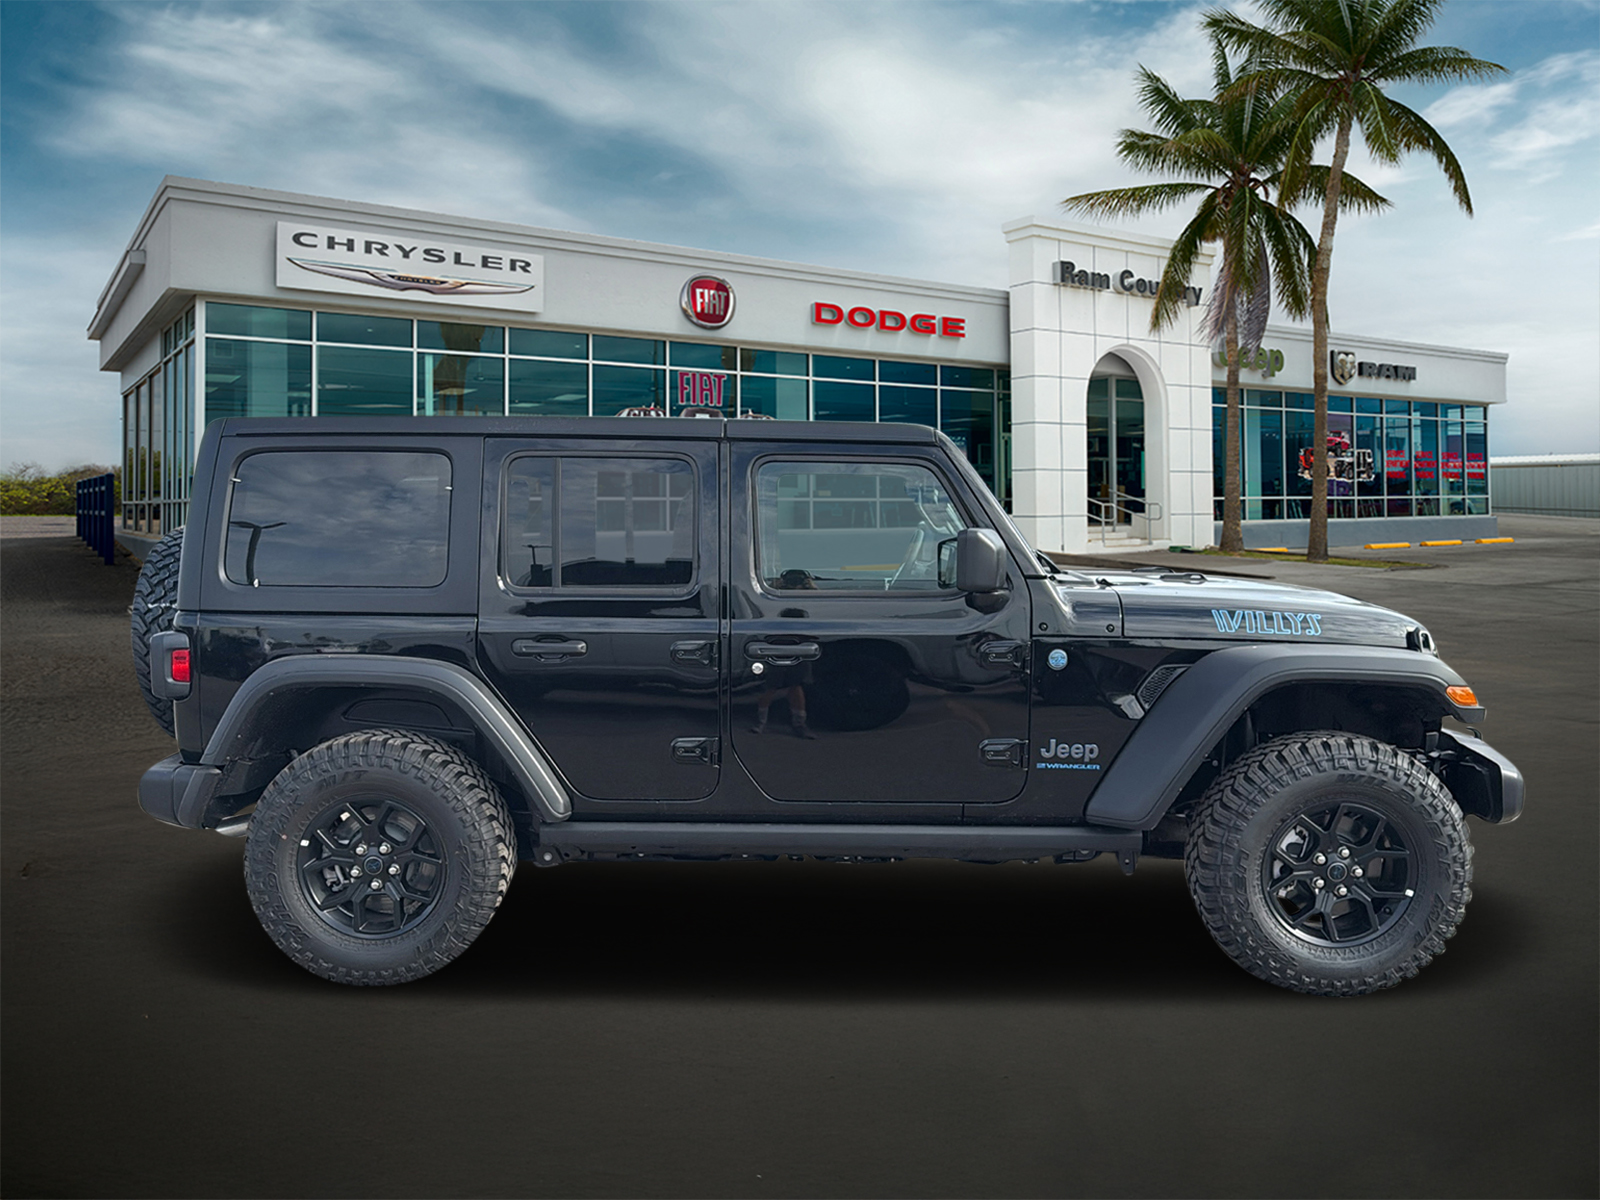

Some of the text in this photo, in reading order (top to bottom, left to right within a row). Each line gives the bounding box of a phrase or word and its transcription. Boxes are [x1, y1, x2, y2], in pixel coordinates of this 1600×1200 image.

[291, 231, 532, 274] CHRYSLER
[1053, 260, 1203, 308] Ram Coury
[695, 288, 727, 316] FIAT
[811, 301, 966, 338] DODGE
[1358, 361, 1417, 380] RAM
[678, 371, 726, 406] FIAT
[1211, 609, 1321, 636] WILLYS
[1040, 738, 1099, 762] Jeep
[1334, 768, 1450, 883] WILDPEAK
